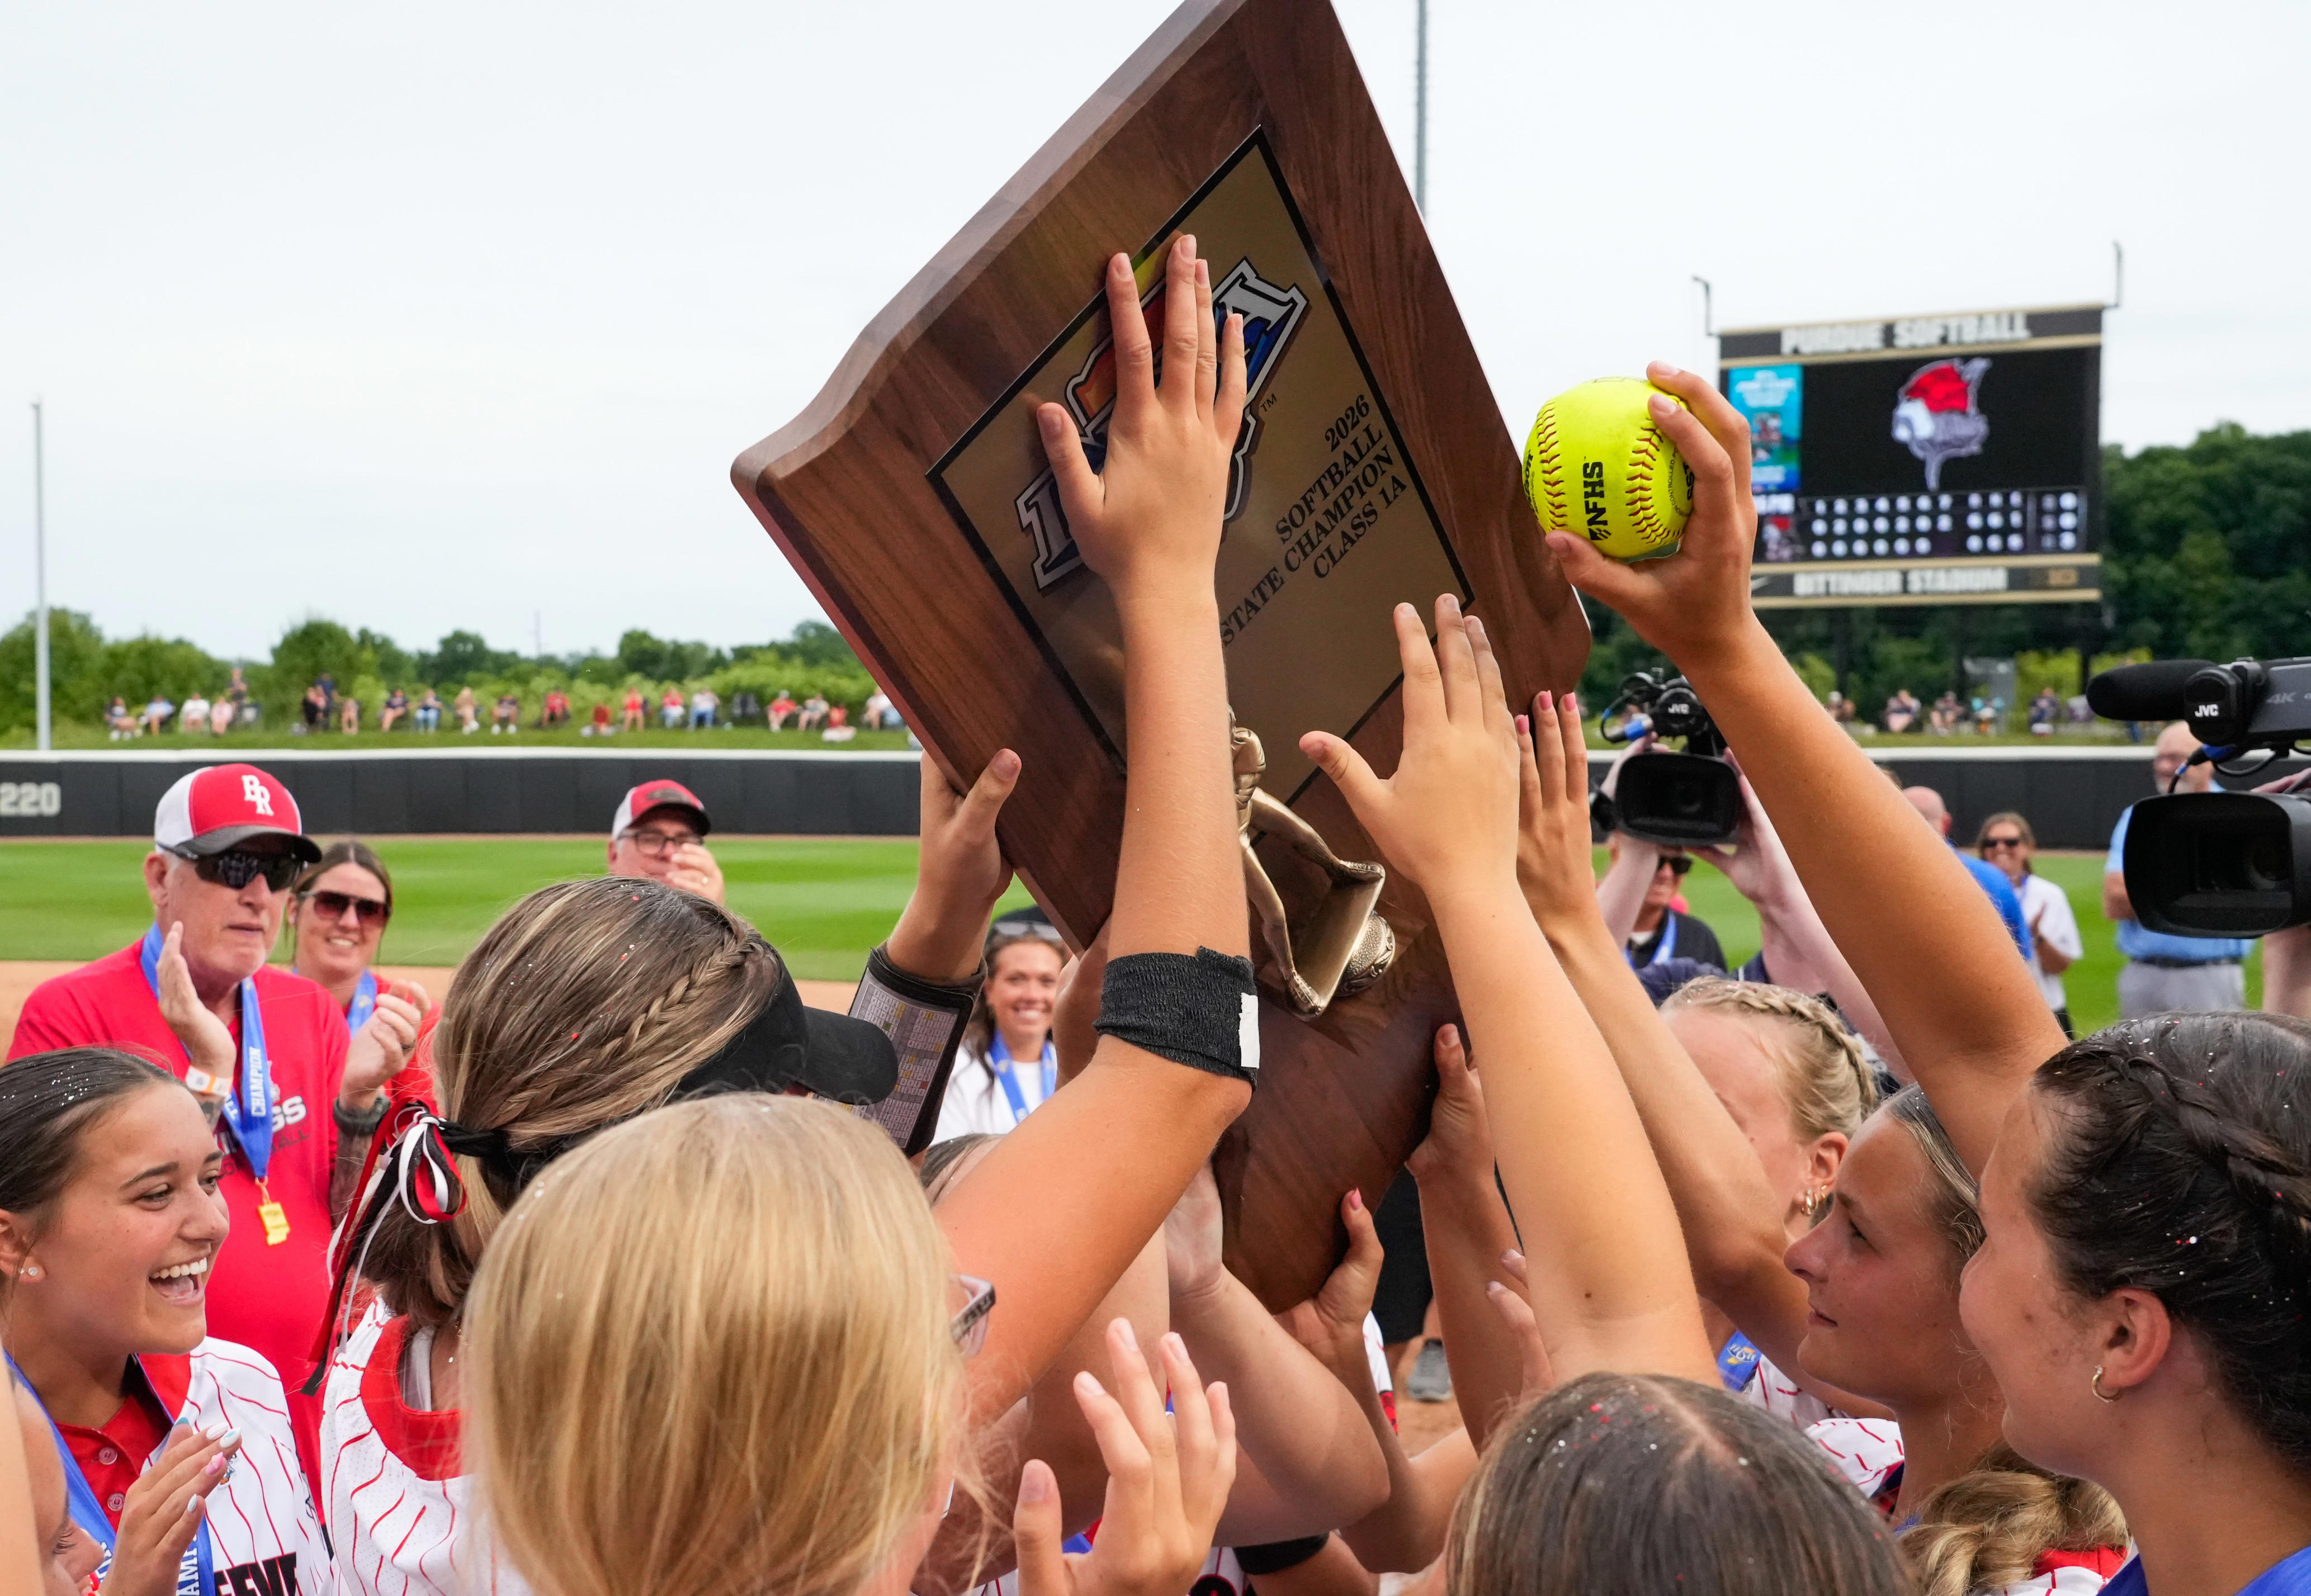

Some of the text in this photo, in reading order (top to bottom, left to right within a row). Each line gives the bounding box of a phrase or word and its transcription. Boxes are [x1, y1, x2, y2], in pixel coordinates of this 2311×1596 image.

[1325, 394, 1370, 452] 2026
[1276, 423, 1383, 544] SOFTBALL
[1583, 461, 1608, 527] NFHS
[1220, 447, 1395, 647] STATE CHAMPION
[1313, 475, 1407, 579] CLASS 1A
[1668, 703, 1689, 714] JVC
[2194, 704, 2219, 718] JVC
[0, 782, 62, 817] 220
[241, 774, 274, 816] BR
[249, 1046, 266, 1117] CHAMPION
